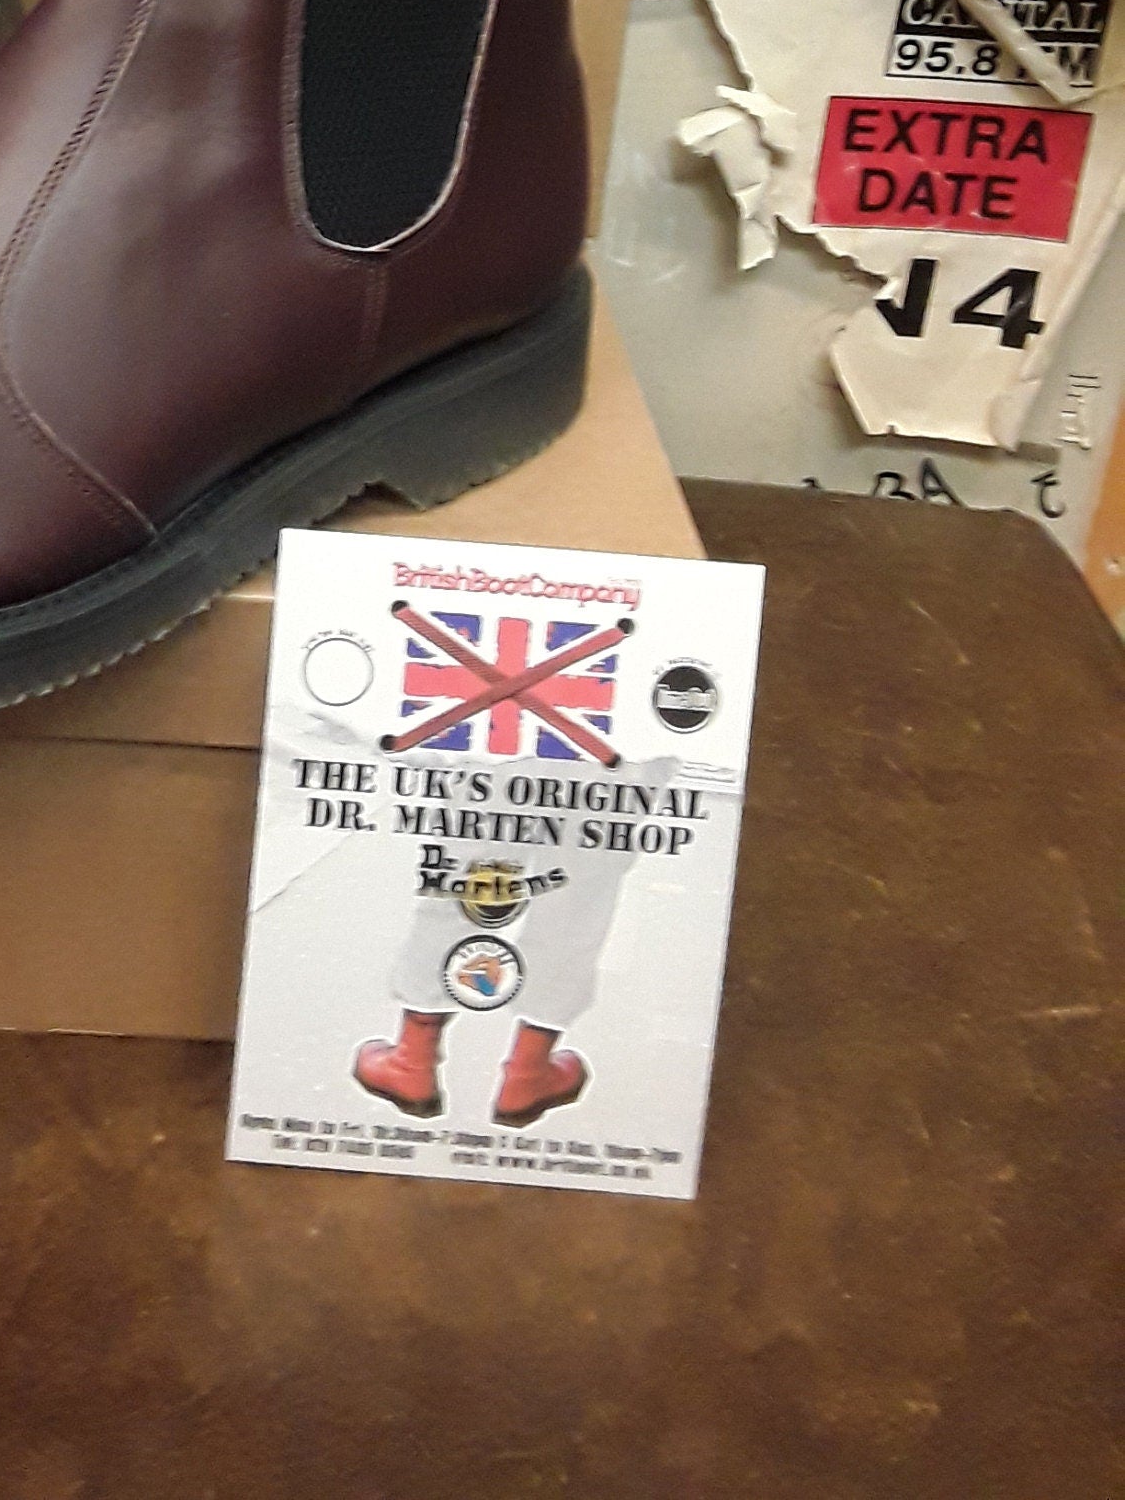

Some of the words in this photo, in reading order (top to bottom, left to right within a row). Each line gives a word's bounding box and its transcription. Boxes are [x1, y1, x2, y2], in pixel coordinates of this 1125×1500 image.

[895, 39, 999, 76] 95.8
[844, 108, 1048, 164] EXTRA
[858, 168, 1018, 219] DATE
[393, 561, 641, 612] BritishBootCompany
[293, 758, 378, 794] THE
[393, 766, 494, 801] UK'S
[506, 775, 711, 821] ORIGINAL
[305, 798, 377, 831] DR.
[393, 804, 566, 847] MARTEN
[578, 820, 695, 856] SHOP
